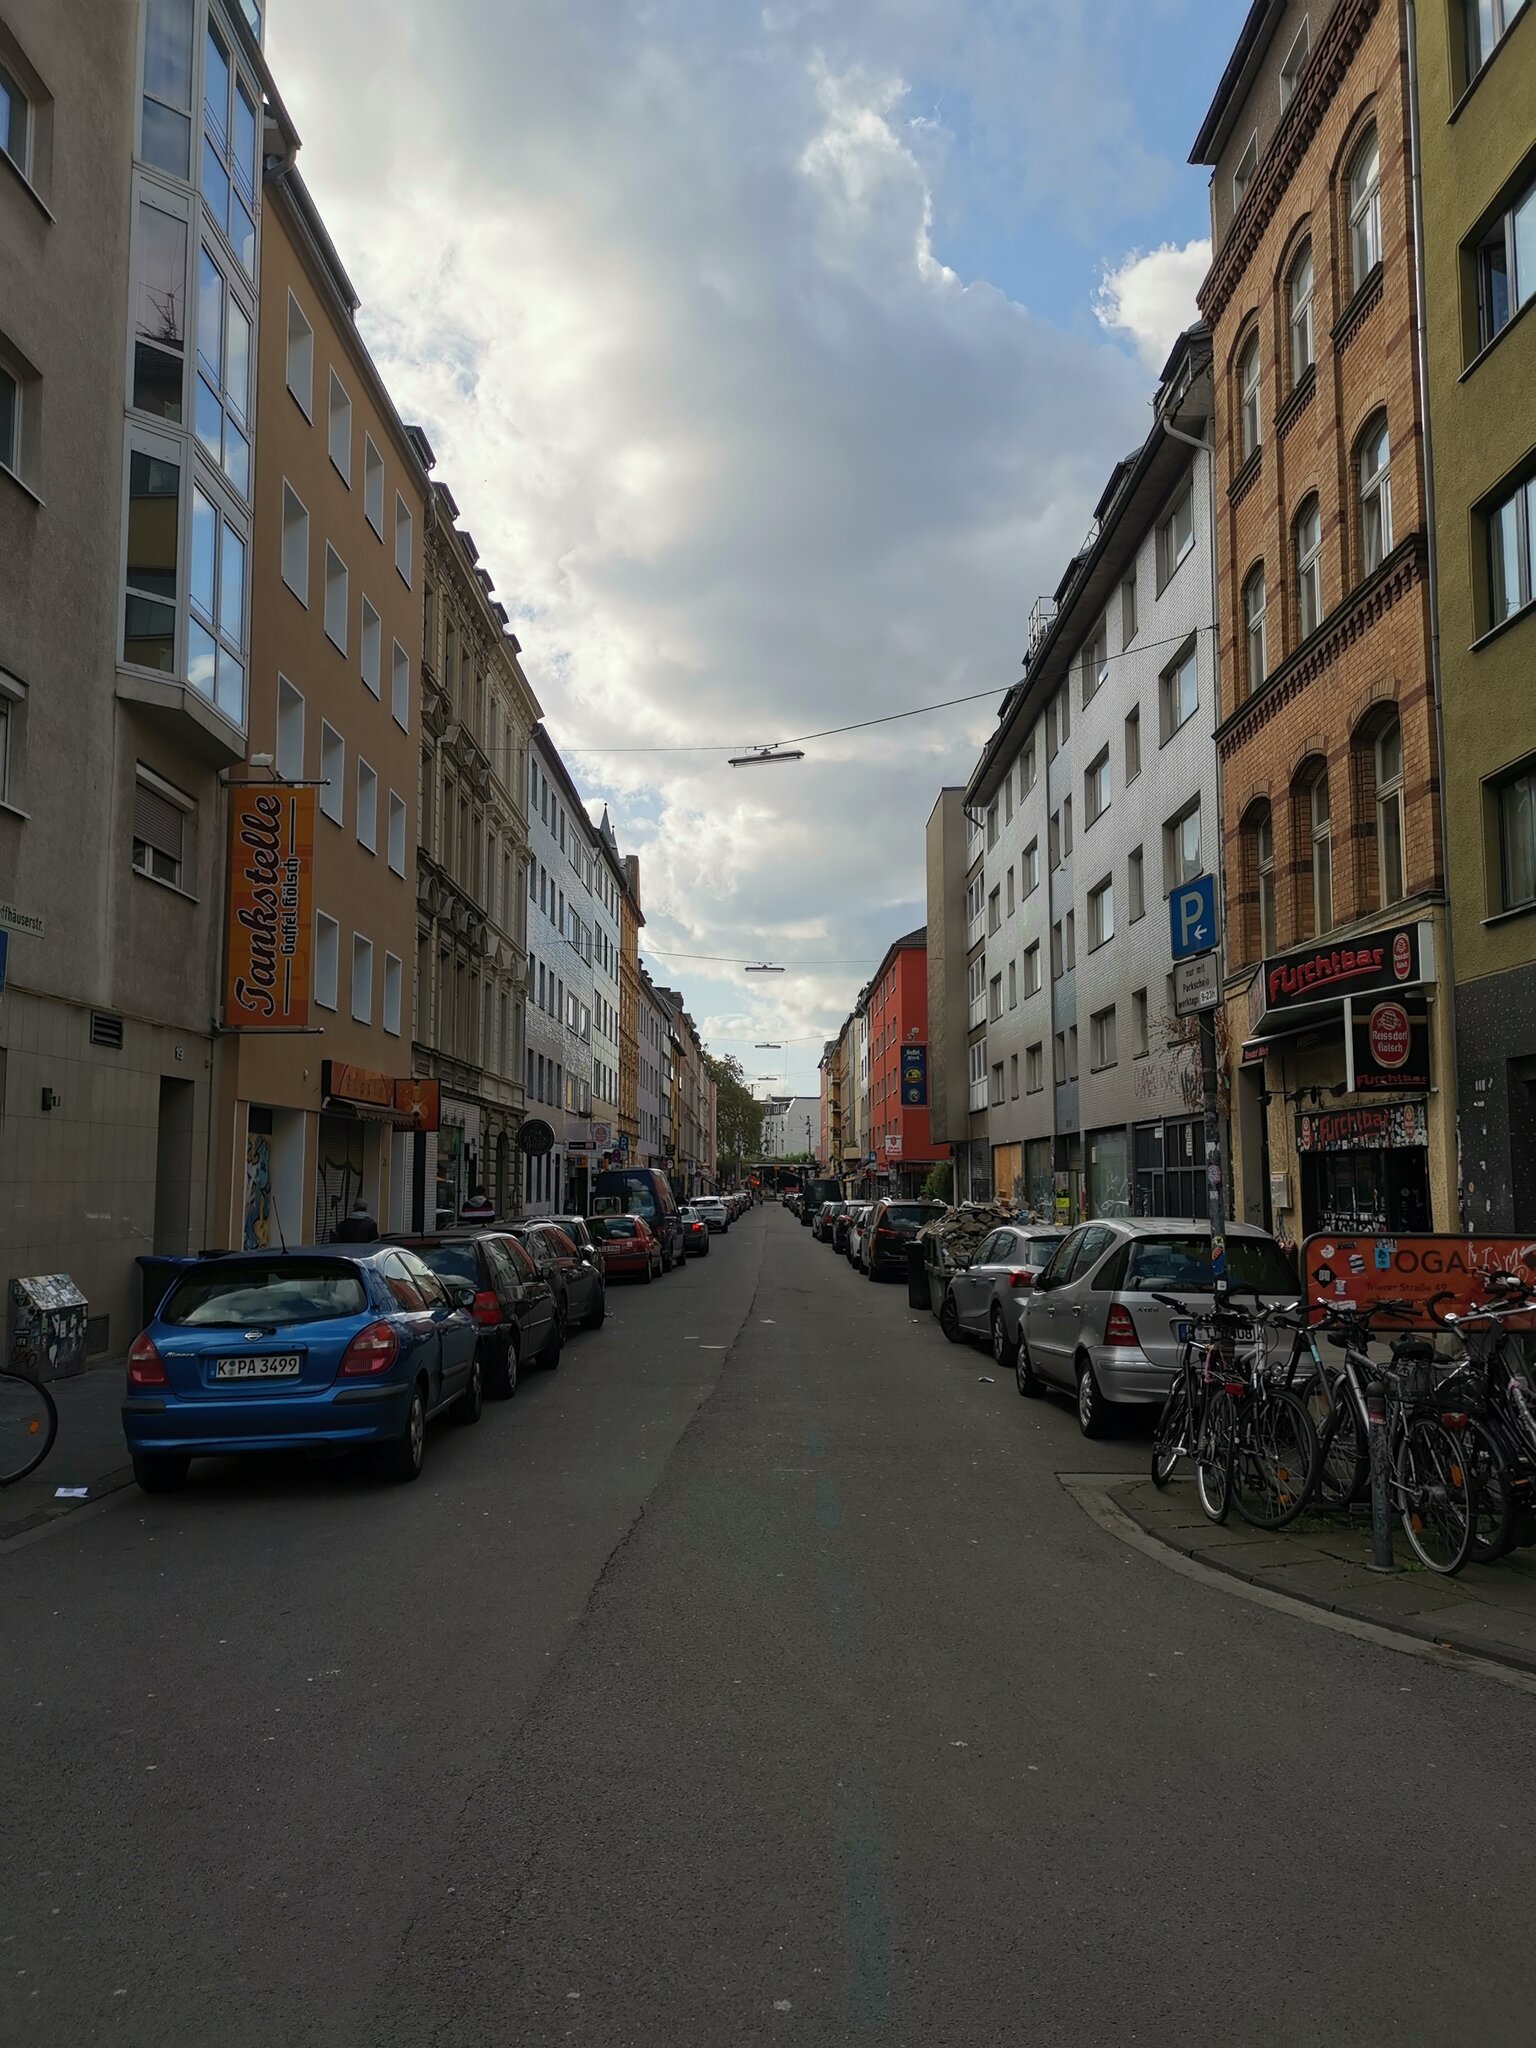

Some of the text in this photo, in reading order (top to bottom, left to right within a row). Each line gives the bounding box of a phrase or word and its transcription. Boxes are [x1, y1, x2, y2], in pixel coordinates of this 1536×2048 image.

[234, 794, 282, 1017] Tankstelle
[281, 857, 299, 955] Gaffel Kölsch
[1180, 891, 1204, 947] P
[1185, 964, 1205, 978] nur mit
[1268, 947, 1385, 1005] Furchtbar
[1183, 977, 1210, 993] Parkschein
[1178, 990, 1216, 1009] werktags 9-23h
[1355, 1072, 1428, 1088] Furchtbar
[1399, 1282, 1432, 1292] Straße
[217, 1358, 297, 1376] K PA 3499
